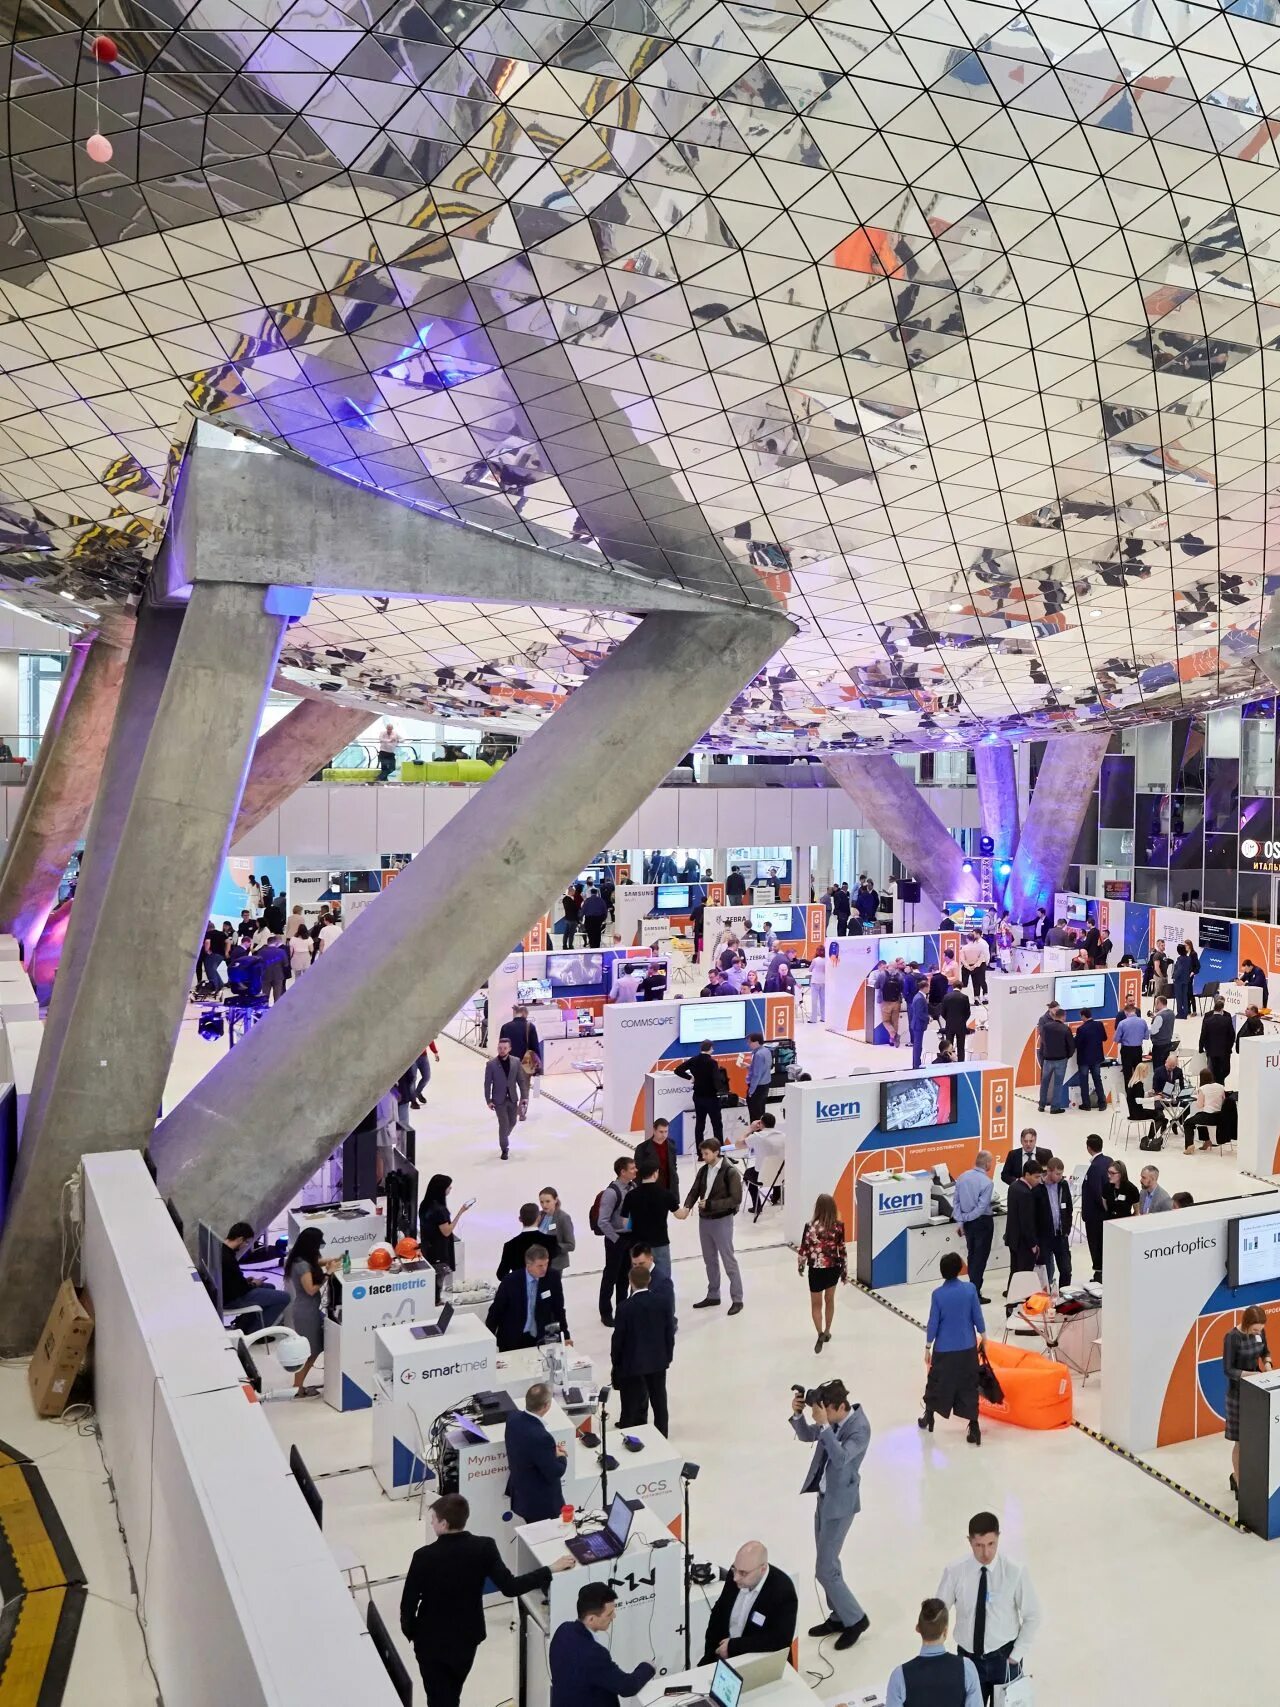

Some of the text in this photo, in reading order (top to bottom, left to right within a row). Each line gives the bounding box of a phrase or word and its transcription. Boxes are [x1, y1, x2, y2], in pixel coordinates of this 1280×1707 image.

[726, 915, 747, 923] ZEBRA
[1018, 984, 1034, 992] Check
[1226, 996, 1240, 1005] CISCO
[621, 1016, 672, 1028] COMMSCOPE
[658, 1086, 693, 1096] COMMSCO
[816, 1101, 860, 1118] kern
[879, 1192, 923, 1211] kern
[331, 1232, 376, 1244] Addreality
[1144, 1236, 1216, 1260] smartoptics
[369, 1278, 426, 1296] facemetric
[364, 1318, 416, 1332] INTACT
[422, 1358, 487, 1380] smartmed
[468, 1466, 509, 1480] решени
[636, 1480, 667, 1495] OCS
[626, 1593, 656, 1607] WORLD
